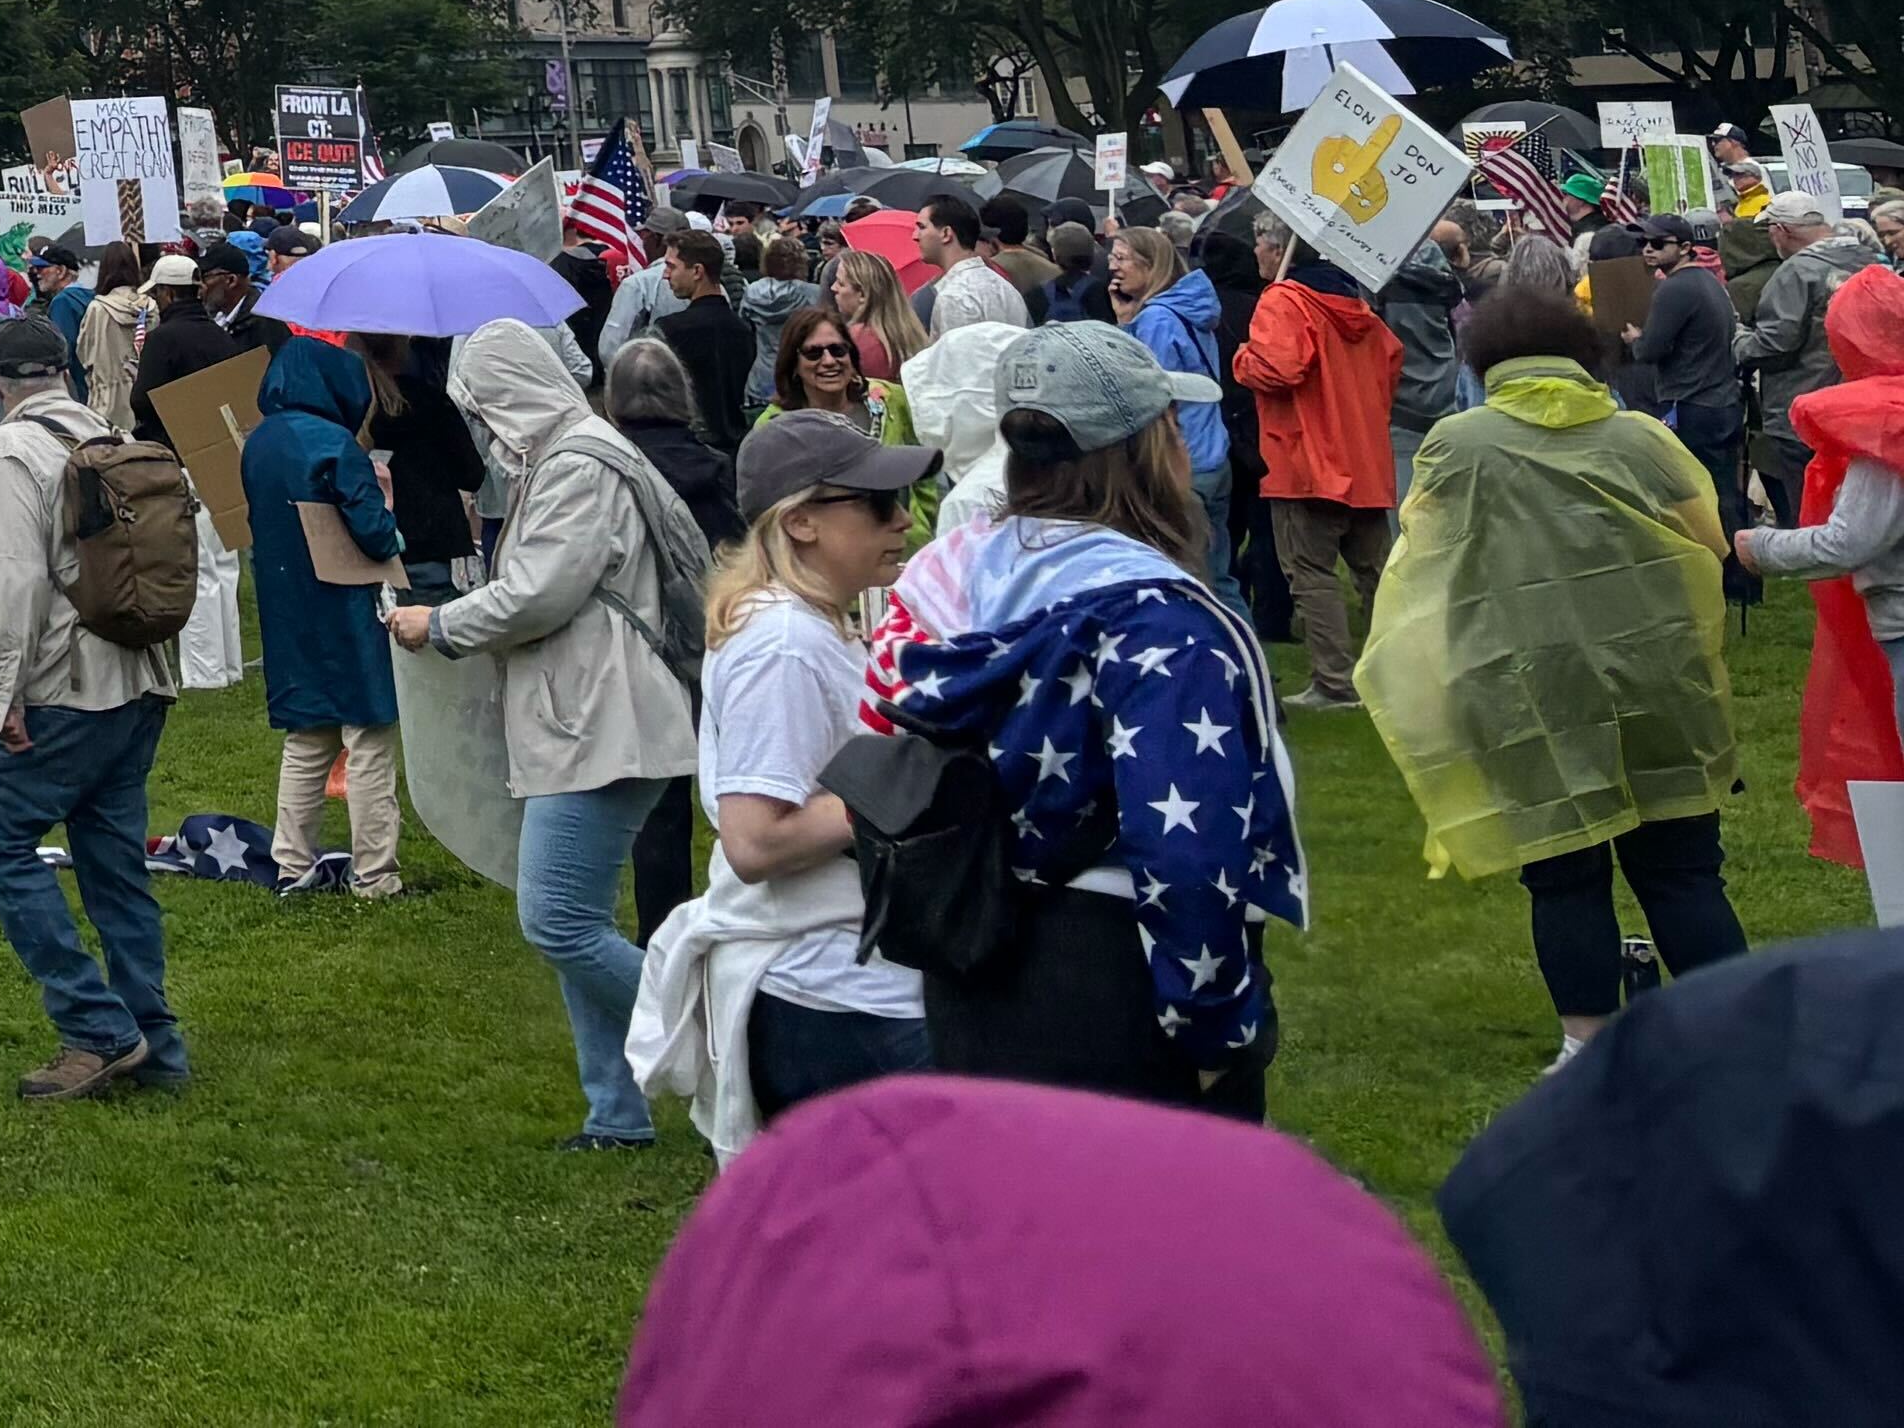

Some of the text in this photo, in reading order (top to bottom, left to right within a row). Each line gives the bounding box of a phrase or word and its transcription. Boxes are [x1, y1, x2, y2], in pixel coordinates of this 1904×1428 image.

[96, 101, 138, 117] MAKE
[280, 94, 352, 116] FROM LA
[1334, 88, 1377, 126] ELON
[75, 115, 170, 152] EMPATHY
[307, 119, 333, 139] CT:
[287, 141, 356, 163] ICE OUT!
[1404, 144, 1445, 177] DON
[1794, 146, 1819, 171] NO
[79, 150, 173, 180] GREAT AGAIN
[10, 201, 34, 214] THIS
[38, 203, 67, 216] MESS
